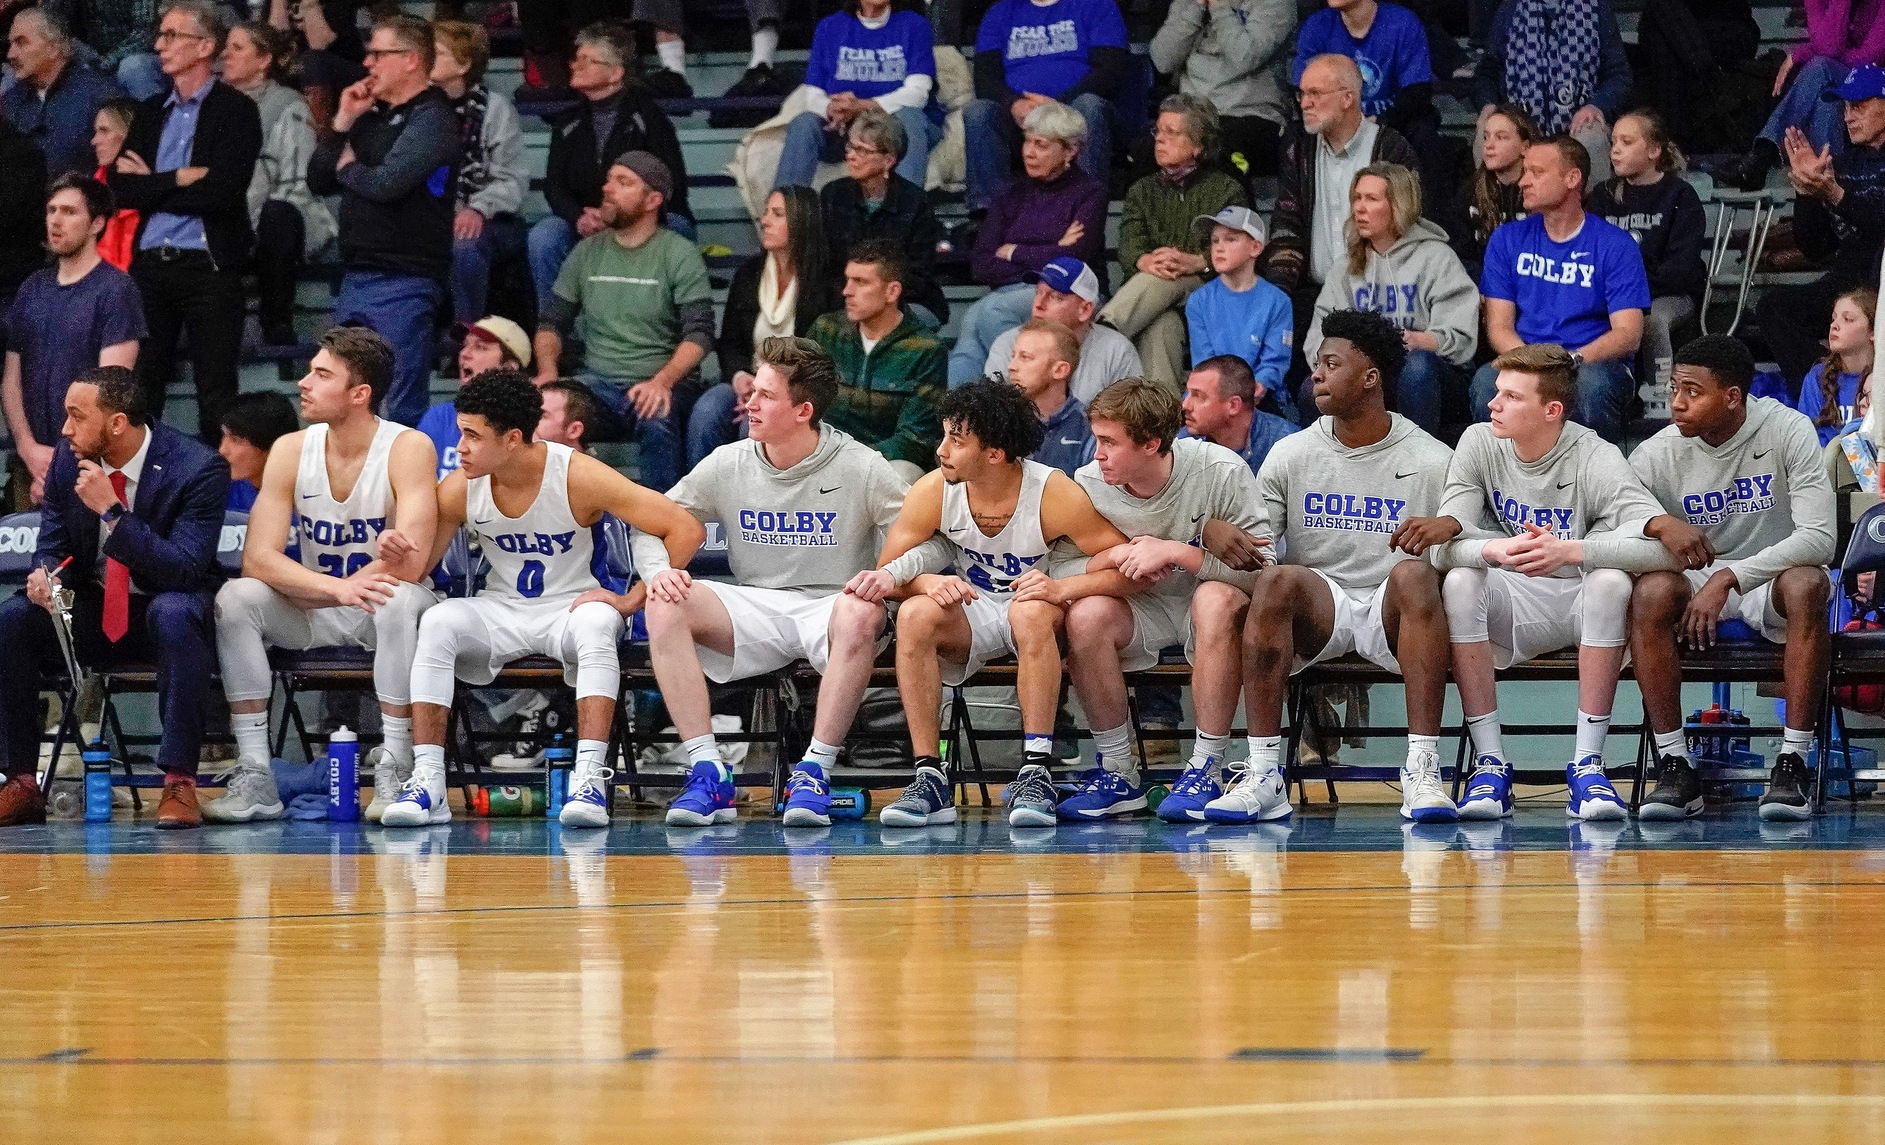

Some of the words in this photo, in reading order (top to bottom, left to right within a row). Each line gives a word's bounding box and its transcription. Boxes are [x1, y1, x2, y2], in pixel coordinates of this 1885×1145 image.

[1516, 252, 1595, 287] COLBY
[1303, 492, 1406, 521] COLBY
[1683, 473, 1774, 515] COLBY
[739, 508, 838, 534] COLBY
[1686, 496, 1777, 525] BASKETBALL
[301, 515, 387, 547] COLBY
[494, 530, 576, 556] OLBY
[741, 531, 838, 546] BASKETBALL
[516, 560, 546, 598] 0
[330, 757, 340, 807] COLBY
